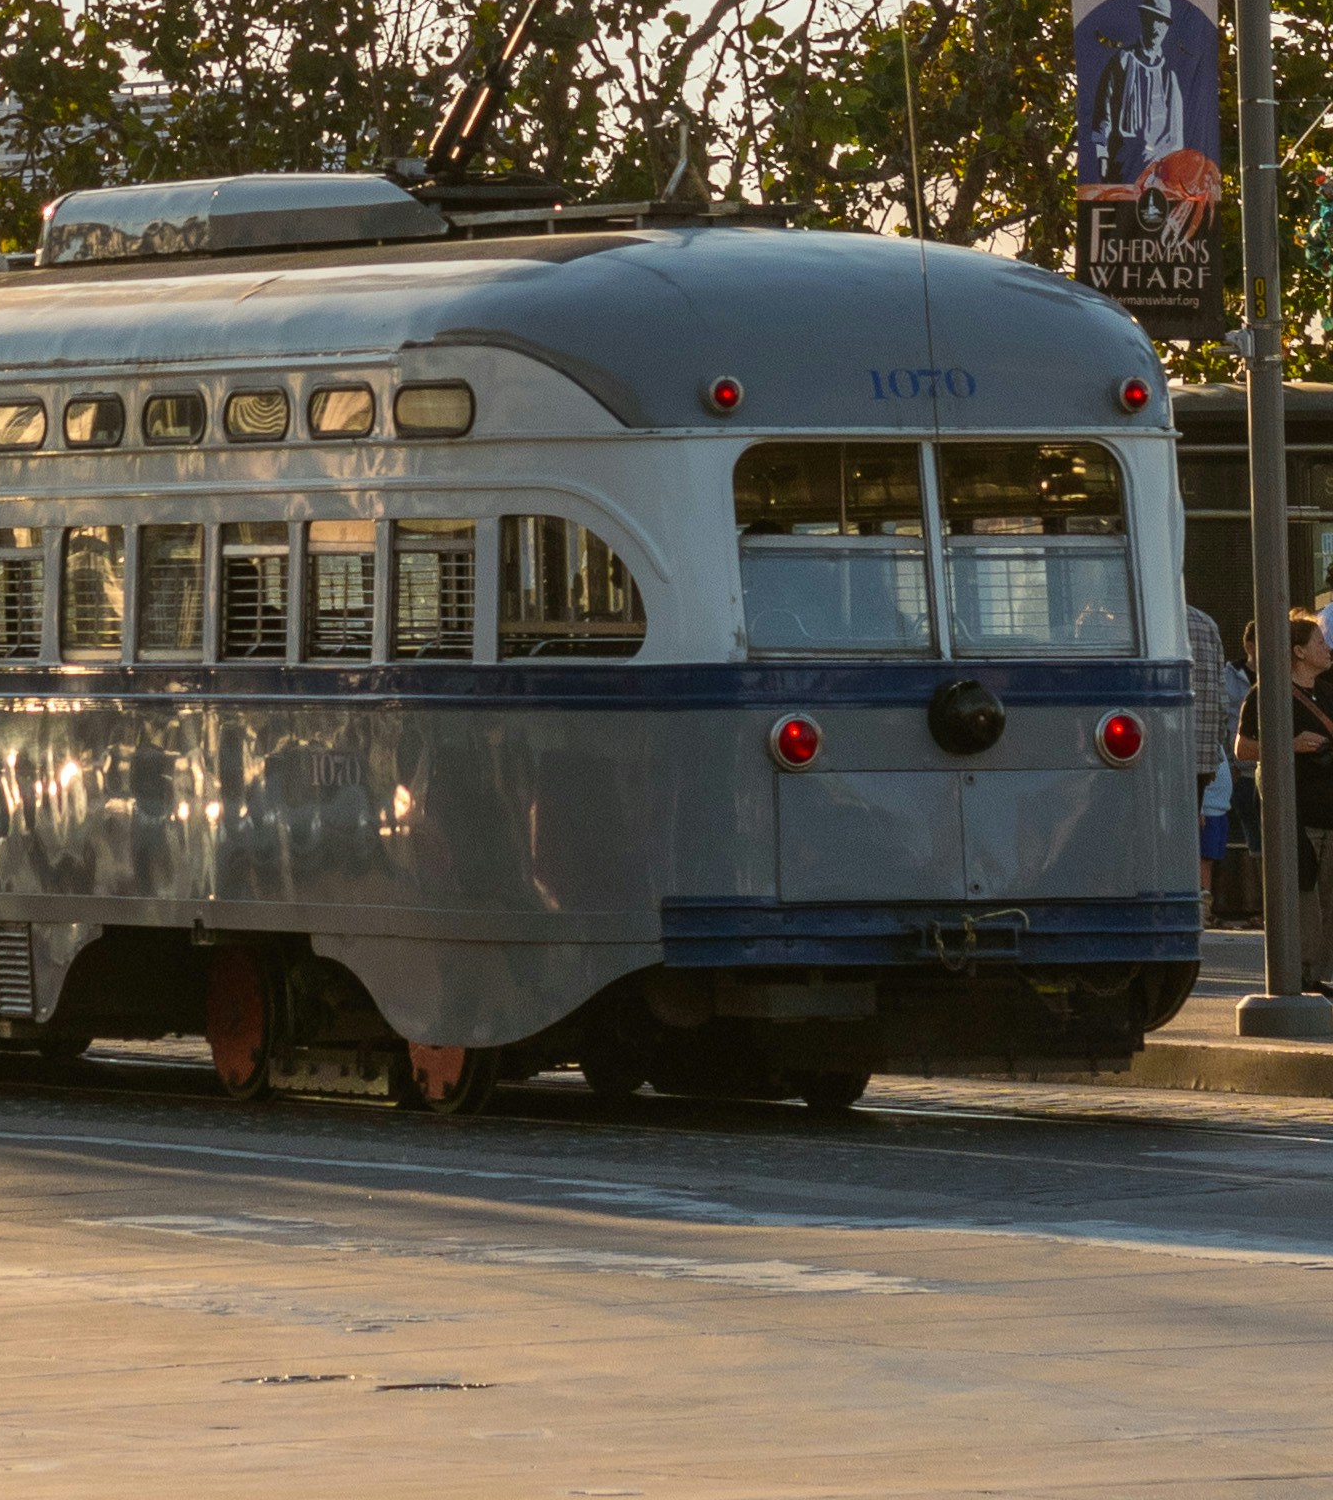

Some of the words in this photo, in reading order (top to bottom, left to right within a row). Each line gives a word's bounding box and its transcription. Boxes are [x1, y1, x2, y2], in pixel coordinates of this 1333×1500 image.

[1089, 207, 1210, 265] FISHERMAN'S
[1089, 266, 1212, 289] WHARF
[1254, 278, 1266, 319] 03
[869, 367, 977, 400] 1070
[312, 754, 362, 787] 1070
